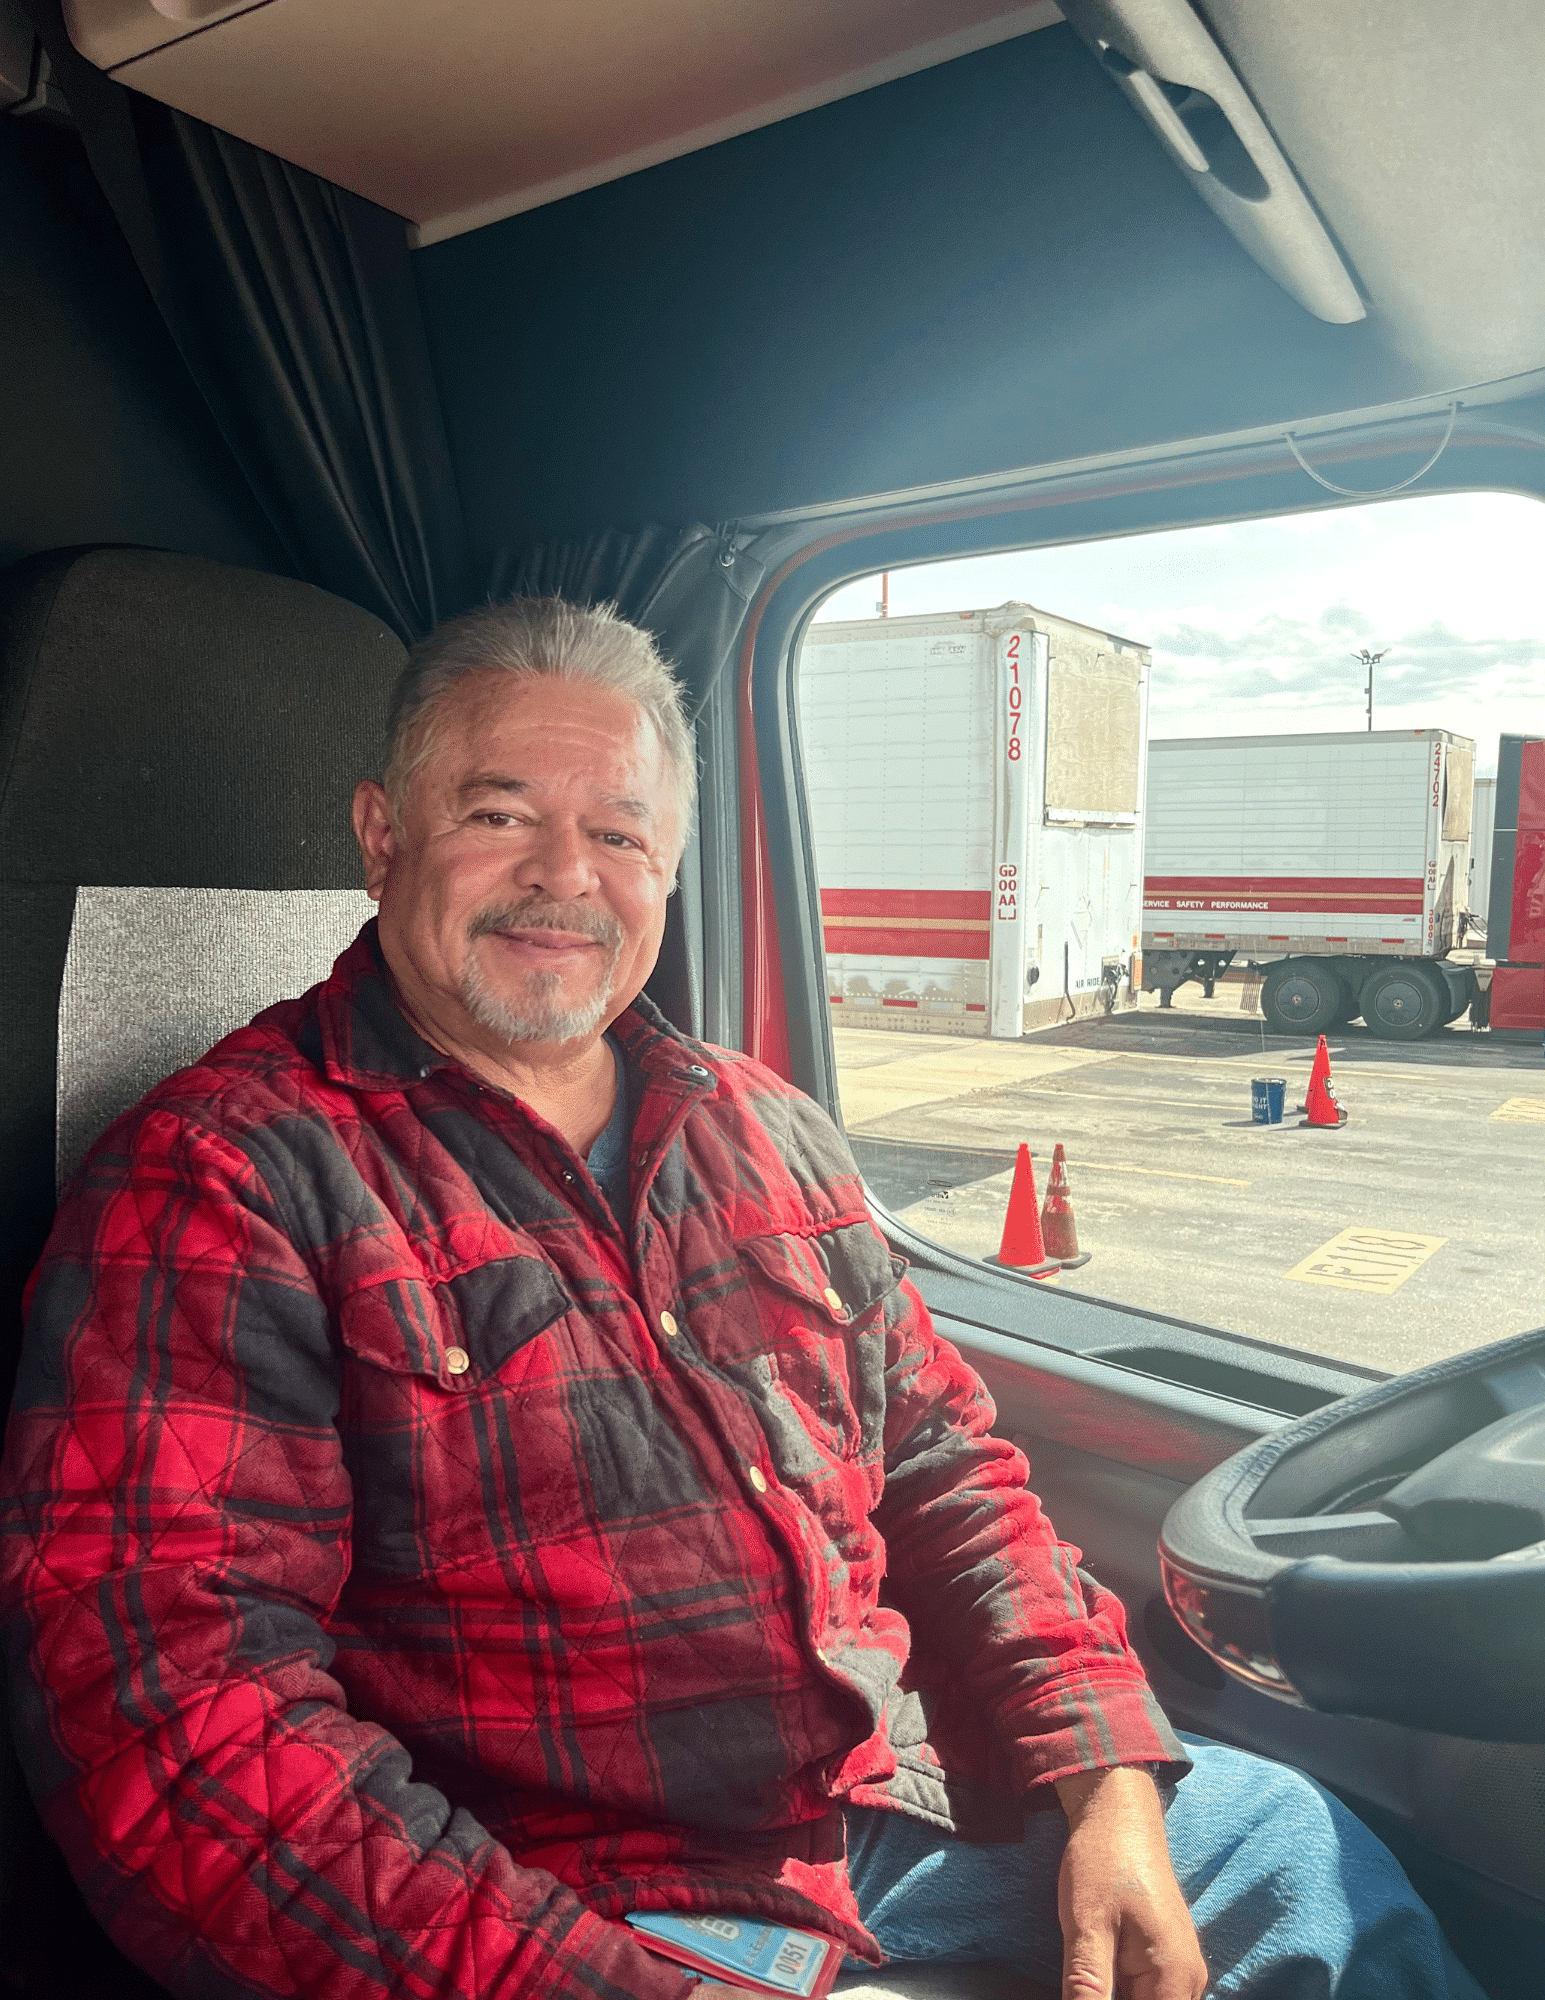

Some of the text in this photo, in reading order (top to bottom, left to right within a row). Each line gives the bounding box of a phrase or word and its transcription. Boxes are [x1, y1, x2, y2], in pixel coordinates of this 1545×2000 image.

[1007, 635, 1021, 761] 21078
[1432, 742, 1441, 807] 24702
[1176, 900, 1204, 909] SAFETY
[1211, 901, 1269, 910] PERFORMANCE
[1075, 977, 1100, 989] AIR RIDE
[1306, 1235, 1428, 1285] R118
[775, 1941, 807, 1975] 0051
